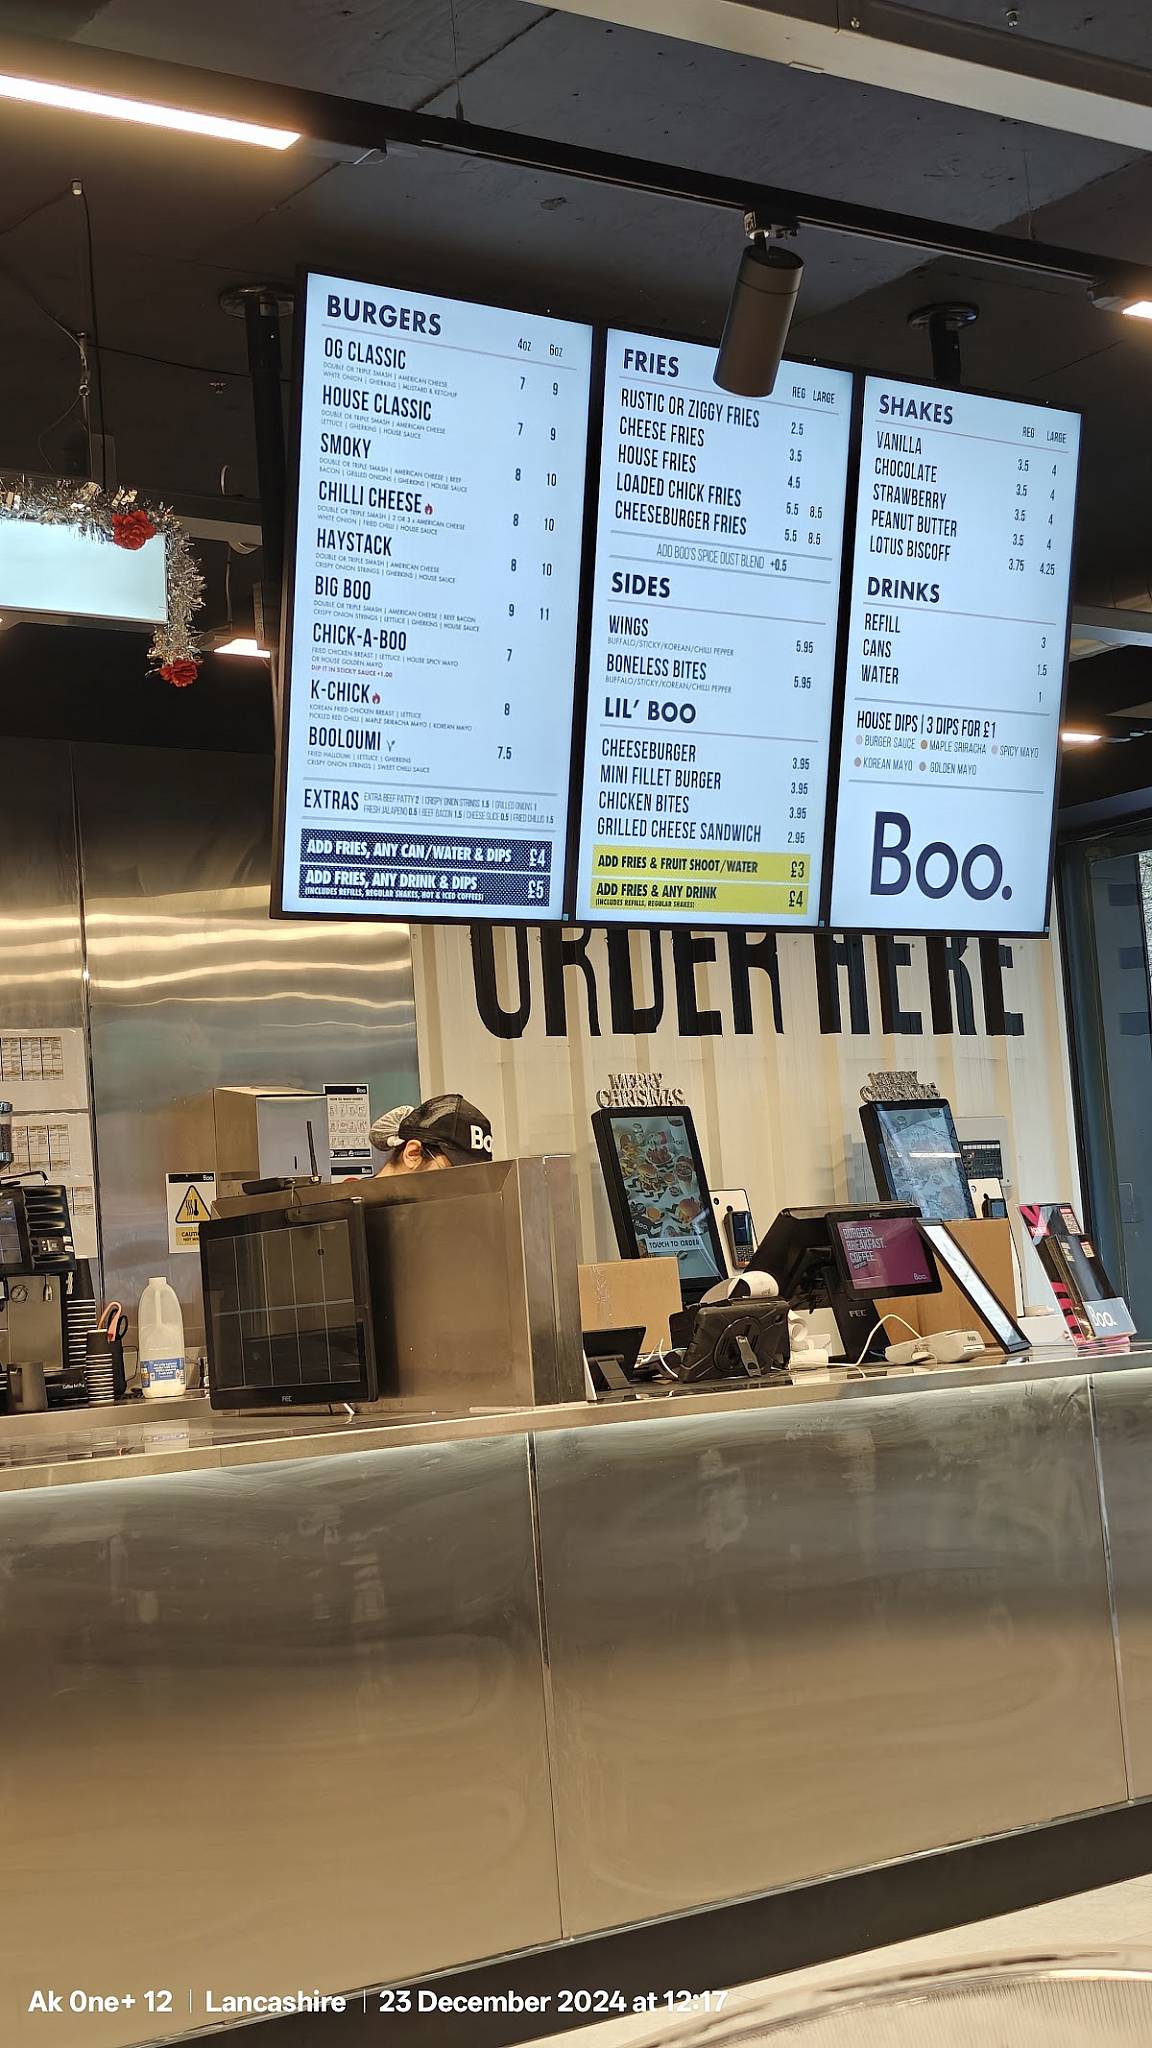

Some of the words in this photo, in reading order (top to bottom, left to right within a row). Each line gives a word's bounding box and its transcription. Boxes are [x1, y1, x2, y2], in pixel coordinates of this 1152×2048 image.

[327, 294, 441, 337] BURGERS
[324, 337, 343, 359] OG
[348, 340, 406, 370] CLASSIC
[517, 337, 531, 352] 4oz
[549, 343, 563, 357] 6oz
[323, 361, 344, 371] DOUBLE
[346, 365, 354, 373] OR
[356, 367, 371, 375] TRIPLE
[373, 369, 392, 378] SMASH
[398, 374, 427, 385] AMERICAN
[427, 378, 447, 388] CHEESE
[623, 348, 679, 378] FRIES
[520, 376, 525, 390] 7
[552, 382, 558, 396] 9
[792, 386, 805, 399] REG
[812, 389, 835, 404] LARGE
[322, 384, 369, 411] HOUSE
[374, 392, 431, 421] CLASSIC
[621, 388, 664, 413] RUSTIC
[668, 395, 684, 416] OR
[688, 398, 723, 423] ZIGGY
[726, 405, 760, 428] FRIES
[879, 393, 953, 426] SHAKES
[321, 418, 342, 427] LETTUCE
[349, 422, 377, 432] GHERKINS
[383, 427, 402, 436] HOUSE
[403, 431, 421, 439] SAUCE
[619, 415, 666, 441] CHEESE
[670, 424, 704, 447] FRIES
[791, 421, 804, 436] 2.5
[1022, 426, 1035, 438] REG
[1046, 430, 1067, 444] LARGE
[320, 432, 371, 459] SMOKY
[876, 430, 922, 455] VANILLA
[618, 444, 658, 468] HOUSE
[662, 450, 696, 474] FRIES
[789, 448, 802, 462] 3.5
[515, 468, 521, 481] 8
[546, 472, 557, 486] 10
[874, 456, 937, 483] CHOCOLATE
[1017, 458, 1029, 472] 3.5
[1051, 464, 1057, 477] 4
[319, 480, 363, 505] CHILLI
[368, 487, 422, 514] CHEESE
[616, 472, 664, 497] LOADED
[668, 479, 704, 502] CHICK
[708, 485, 741, 508] FRIES
[873, 482, 946, 510] STRAWBERRY
[615, 499, 710, 531] CHEESEBURGER
[713, 513, 747, 535] FRIES
[786, 501, 799, 516] 5.5
[809, 505, 822, 519] 8.5
[871, 509, 914, 532] PEANUT
[917, 515, 957, 538] BUTTER
[317, 527, 392, 556] HAYSTACK
[869, 535, 904, 556] LOTUS
[907, 539, 951, 562] BISCOFF
[656, 543, 673, 558] ADD
[697, 548, 718, 564] SPICE
[720, 551, 740, 566] DUST
[740, 553, 765, 569] BLEND
[769, 557, 787, 572] +0.5
[1008, 558, 1024, 572] 3.75
[1039, 562, 1055, 576] 4.25
[315, 575, 338, 597] BIG
[343, 578, 371, 601] BOO
[611, 571, 670, 599] SIDES
[867, 576, 940, 603] DRINKS
[508, 603, 515, 617] 9
[540, 607, 549, 621] 11
[864, 612, 901, 634] REFILL
[313, 622, 406, 651] CHICK-A-BOO
[608, 614, 648, 637] WINGS
[713, 647, 734, 656] PEPPER
[796, 640, 813, 653] 5.95
[863, 638, 891, 658] CANS
[1041, 637, 1046, 648] 3
[506, 648, 512, 662] 7
[606, 653, 669, 677] BONELESS
[673, 659, 707, 680] BITES
[861, 664, 899, 684] WATER
[1037, 663, 1047, 676] 1.5
[311, 679, 370, 704] K-CHICK
[793, 675, 811, 689] 5.95
[1038, 691, 1042, 703] 1
[647, 700, 696, 724] BOO
[857, 710, 892, 730] HOUSE
[894, 713, 918, 733] DIPS
[926, 716, 933, 734] 3
[936, 717, 959, 736] DIPS
[961, 719, 981, 737] FOR
[983, 720, 996, 738] £1
[309, 726, 380, 751] BOOLOUMI
[601, 738, 696, 762] CHEESEBURGER
[864, 734, 892, 748] BURGER
[893, 736, 916, 749] SAUCE
[929, 739, 952, 752] MAPLE
[953, 741, 986, 754] SRIRACHA
[497, 746, 512, 760] 7.5
[999, 745, 1019, 757] SPICY
[1019, 746, 1039, 758] MAYO
[792, 757, 810, 770] 3.95
[863, 756, 891, 770] KOREAN
[892, 758, 913, 771] MAYO
[929, 761, 955, 774] GOLDEN
[957, 763, 976, 775] MAYO
[600, 764, 628, 784] MINI
[632, 766, 671, 786] FILLET
[675, 769, 721, 790] BURGER
[304, 788, 359, 811] EXTRAS
[598, 790, 651, 811] CHICKEN
[655, 794, 689, 813] BITES
[597, 817, 647, 837] GRILLED
[651, 820, 696, 839] CHEESE
[700, 822, 761, 842] SANDWICH
[787, 831, 805, 844] 2.95
[597, 854, 618, 867] ADD
[621, 855, 647, 868] FRIES
[649, 857, 657, 869] &
[660, 857, 687, 870] FRUIT
[689, 858, 757, 874] SHOOT/WATER
[870, 811, 1017, 901] Boo.
[790, 860, 804, 878] £3
